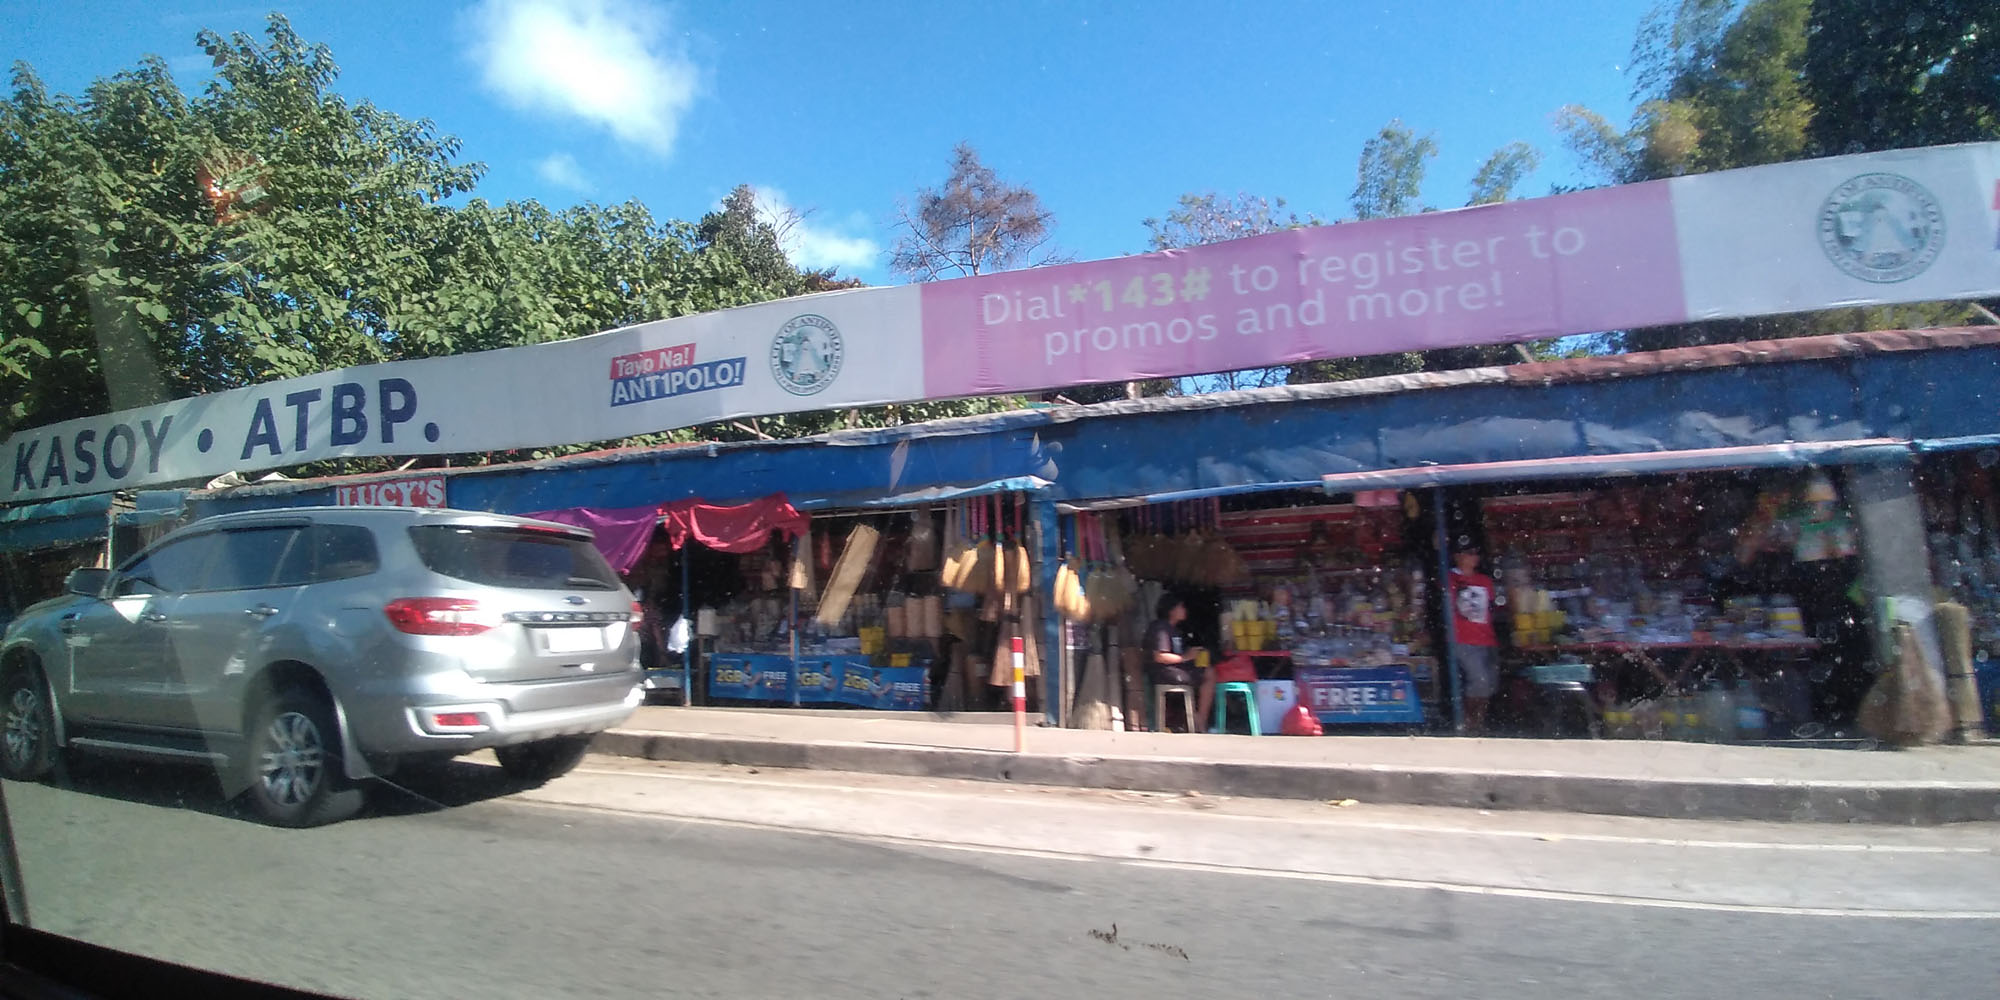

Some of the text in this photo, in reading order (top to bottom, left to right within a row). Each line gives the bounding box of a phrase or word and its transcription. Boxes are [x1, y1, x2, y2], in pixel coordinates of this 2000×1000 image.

[1229, 263, 1279, 295] to
[1299, 234, 1505, 290] register
[1524, 225, 1585, 259] to
[1045, 271, 1504, 365] promos and more!
[616, 347, 690, 378] Tayo Na!
[12, 377, 440, 491] KASOY ATBP.
[341, 480, 443, 506] LUCY'S
[799, 672, 821, 687] GB
[1314, 687, 1377, 705] FREE
